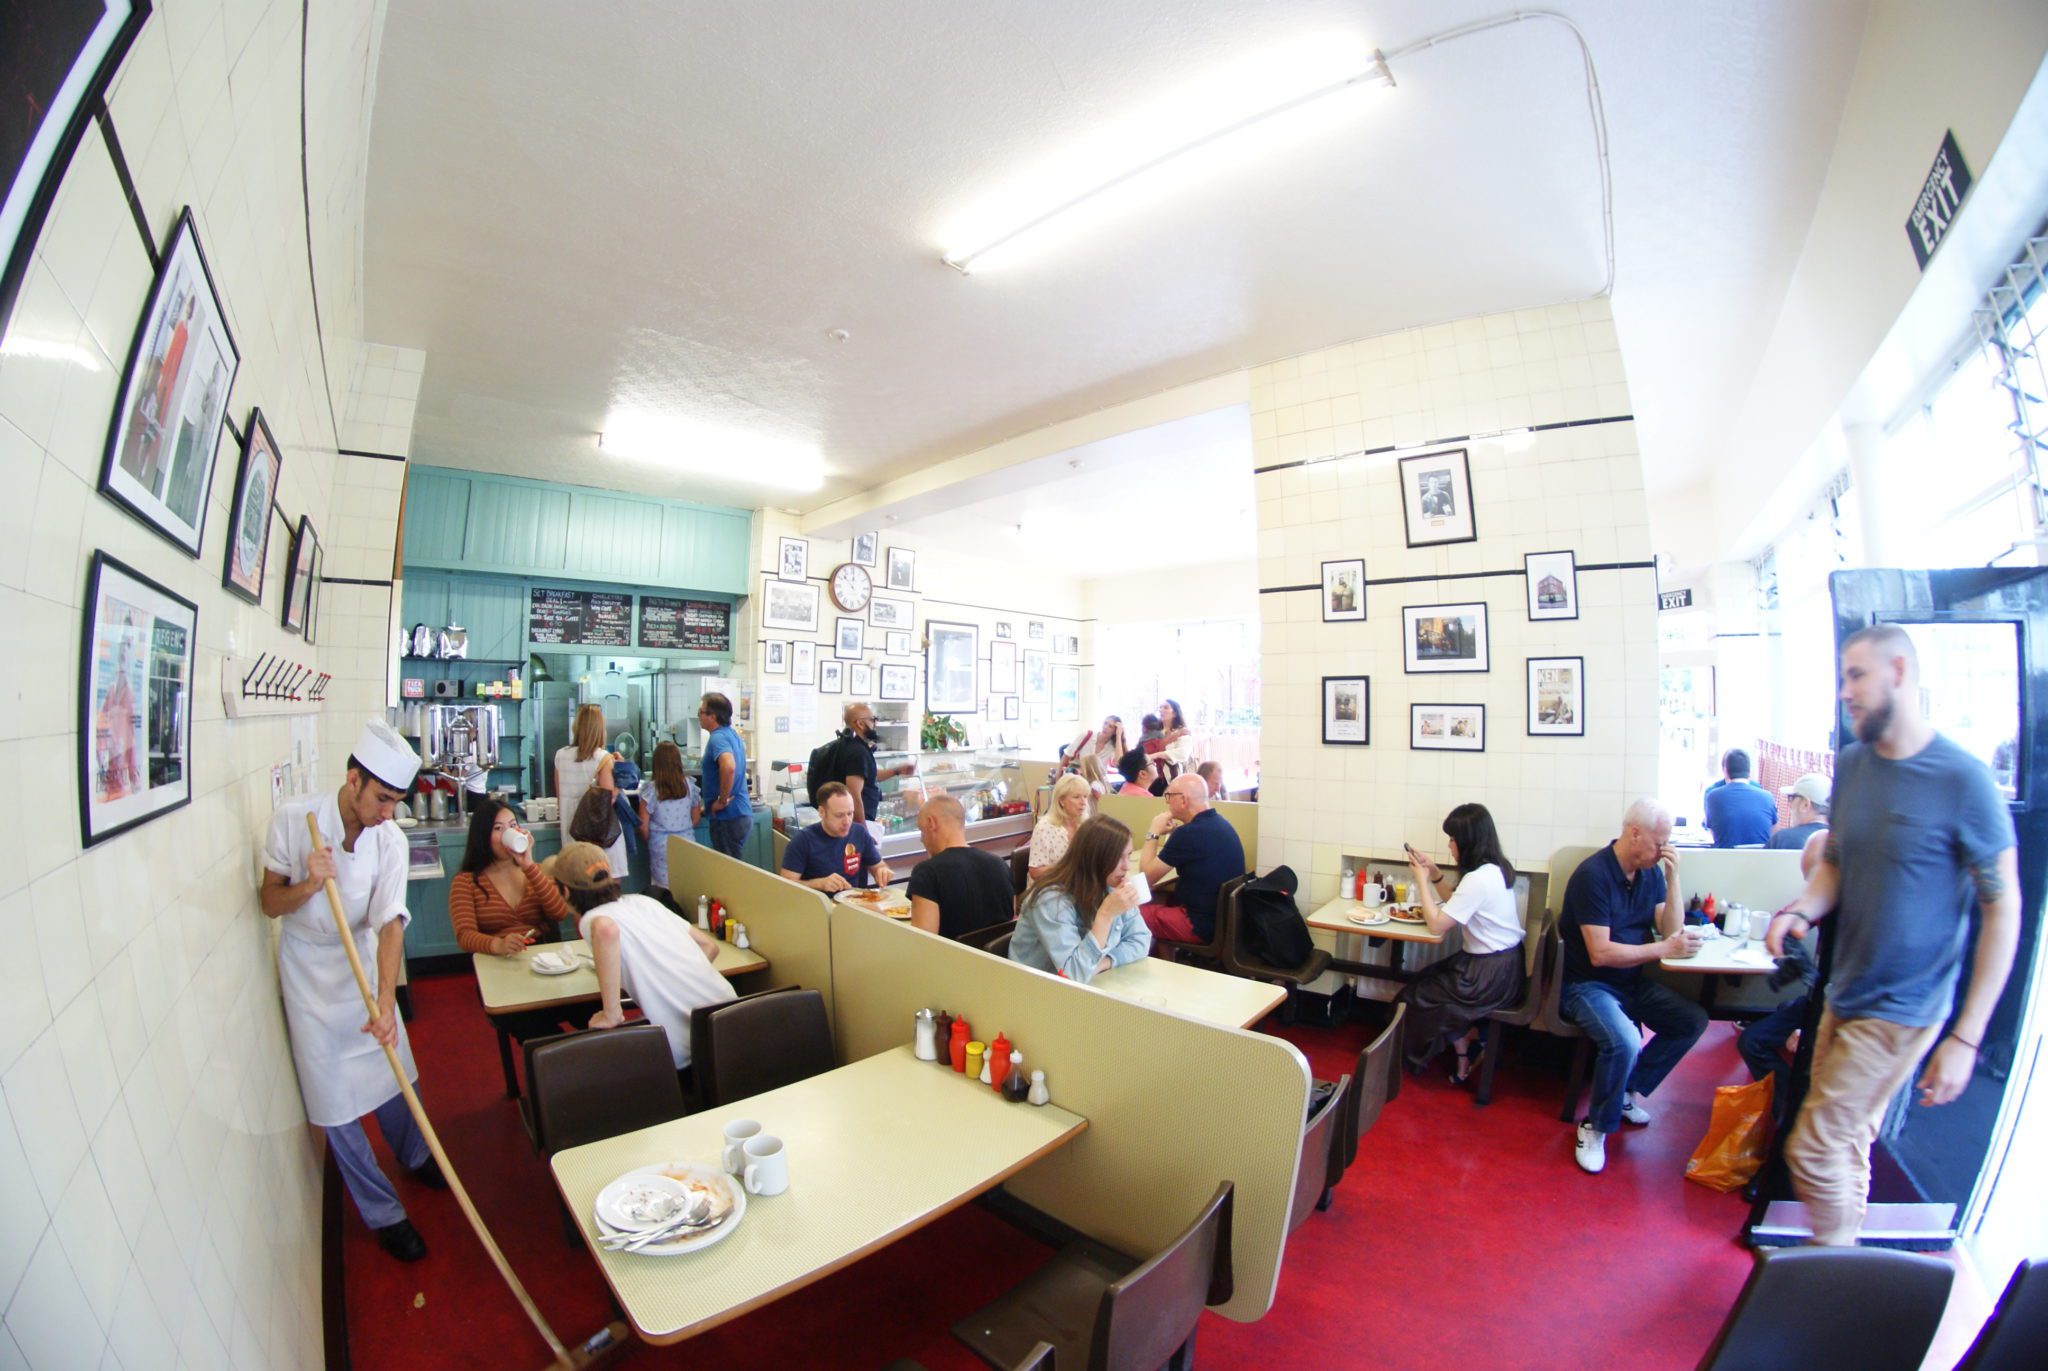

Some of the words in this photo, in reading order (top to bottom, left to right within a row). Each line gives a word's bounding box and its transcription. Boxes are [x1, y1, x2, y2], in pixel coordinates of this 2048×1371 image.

[1911, 149, 1949, 227] EMERGENCY
[1917, 165, 1960, 256] EXIT
[1662, 596, 1687, 609] EXIT
[1537, 669, 1559, 682] KEN
